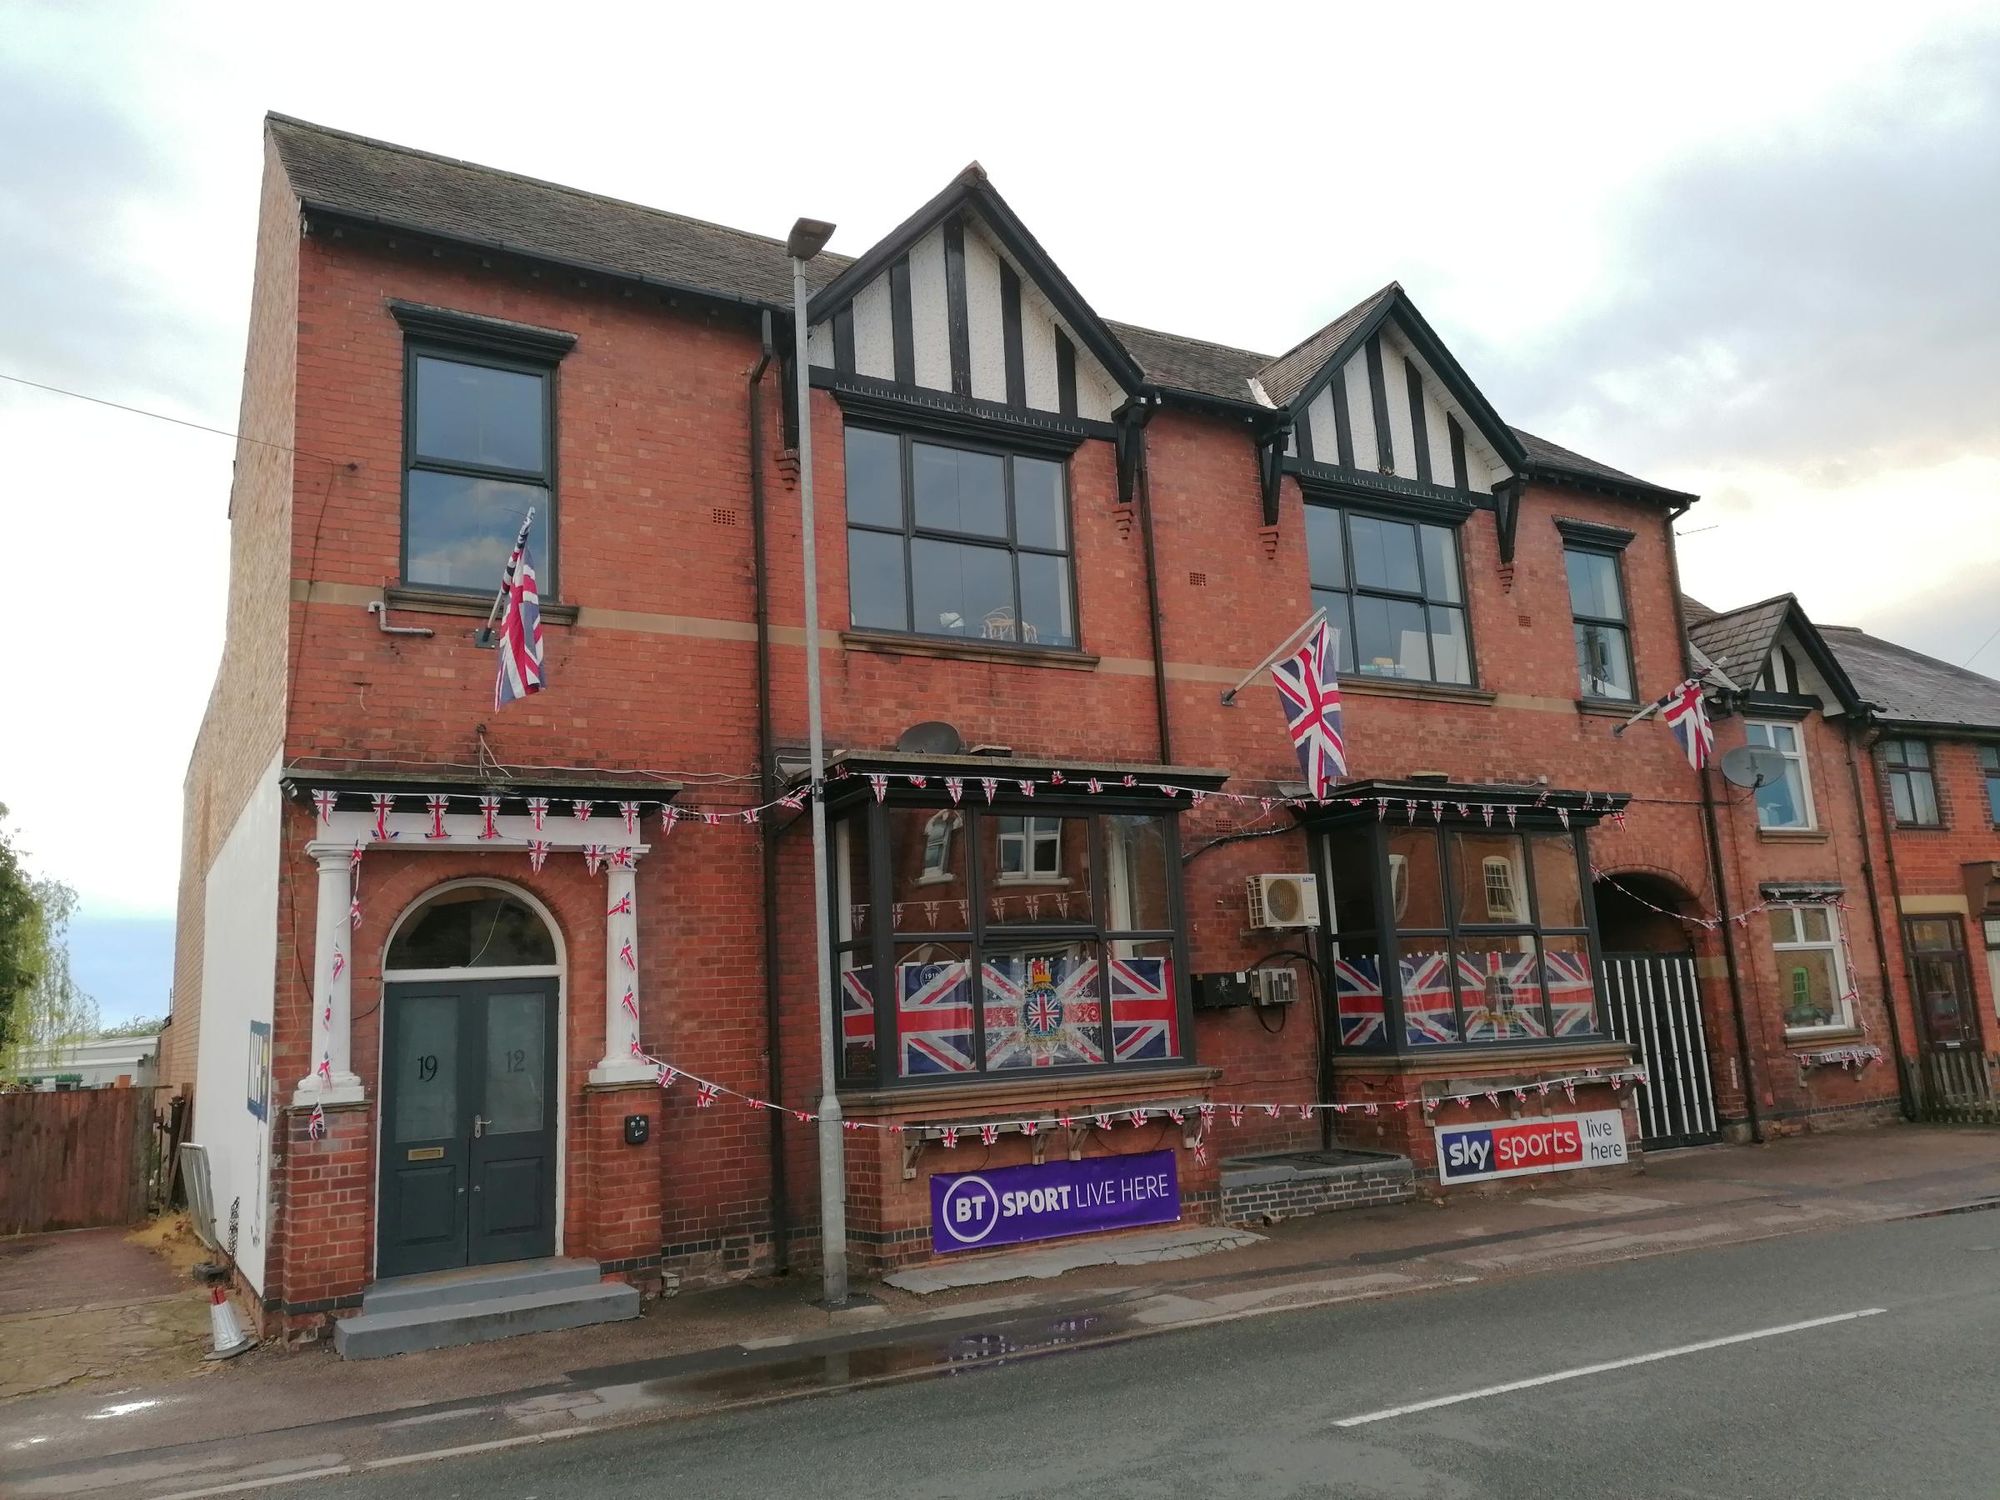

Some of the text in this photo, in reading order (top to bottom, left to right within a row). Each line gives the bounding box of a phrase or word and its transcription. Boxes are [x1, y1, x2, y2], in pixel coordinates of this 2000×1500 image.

[417, 1049, 525, 1082] 19 12
[1586, 1119, 1612, 1138] live
[1449, 1128, 1577, 1169] sky sports
[1590, 1142, 1622, 1160] here
[956, 1174, 1169, 1223] BT SPORT LIVE HERE
